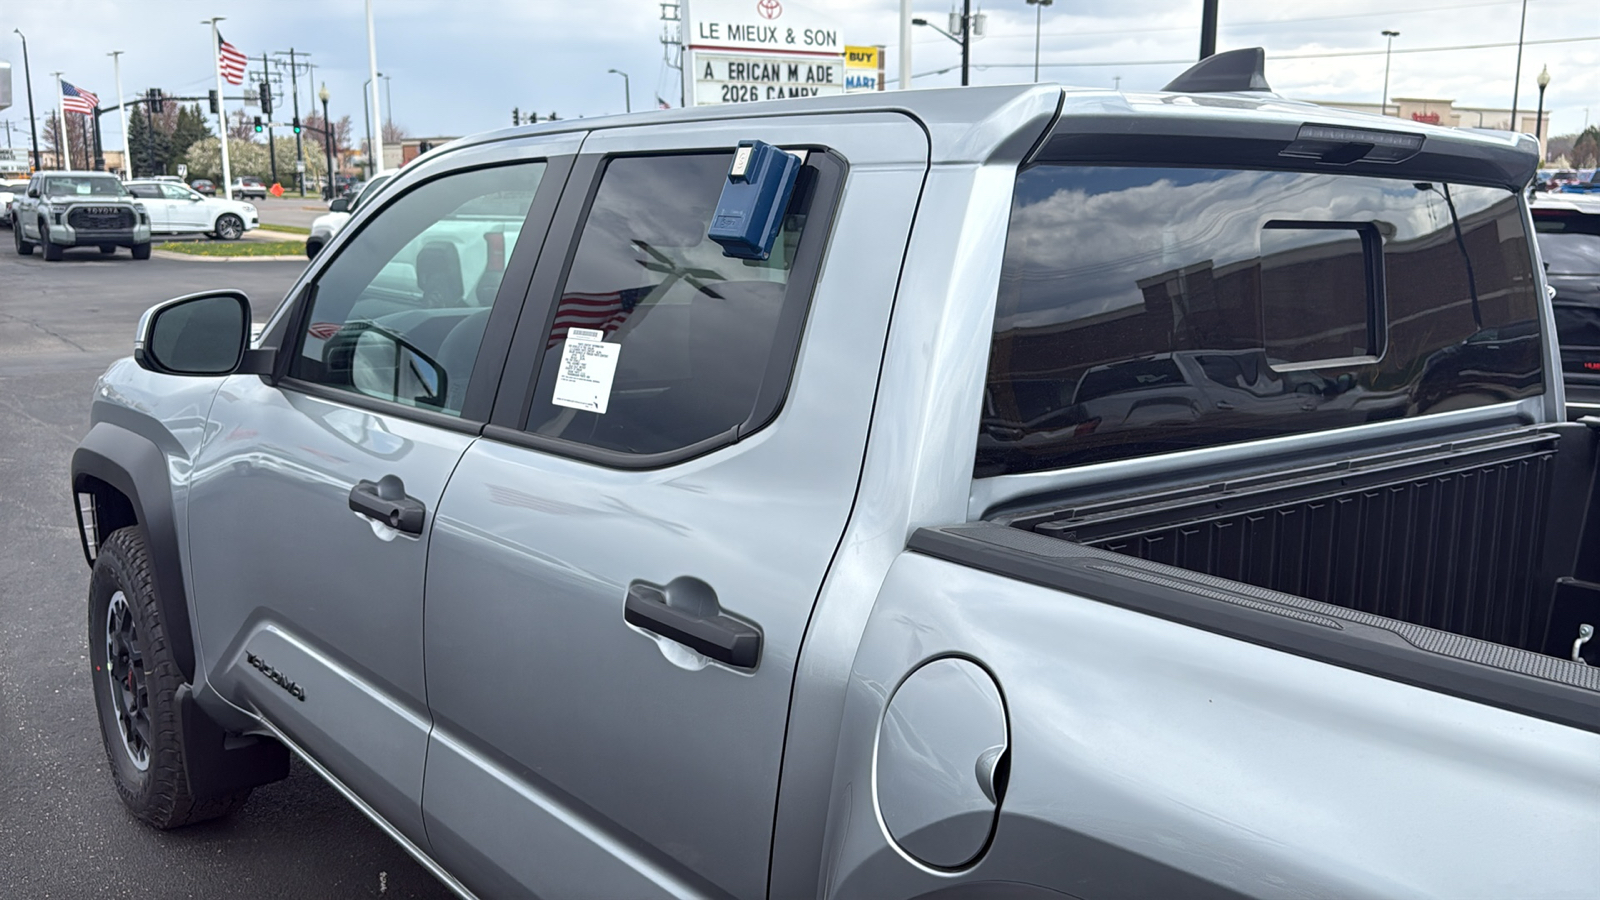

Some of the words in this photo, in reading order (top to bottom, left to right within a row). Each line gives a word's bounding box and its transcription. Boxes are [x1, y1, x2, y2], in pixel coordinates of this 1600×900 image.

[699, 22, 720, 39] LE
[727, 24, 778, 43] MIEUX
[785, 27, 796, 44] &
[803, 28, 836, 47] SON
[849, 52, 872, 62] BUY
[845, 76, 875, 90] MART
[721, 84, 758, 103] 2026
[245, 650, 305, 702] TACOMA
